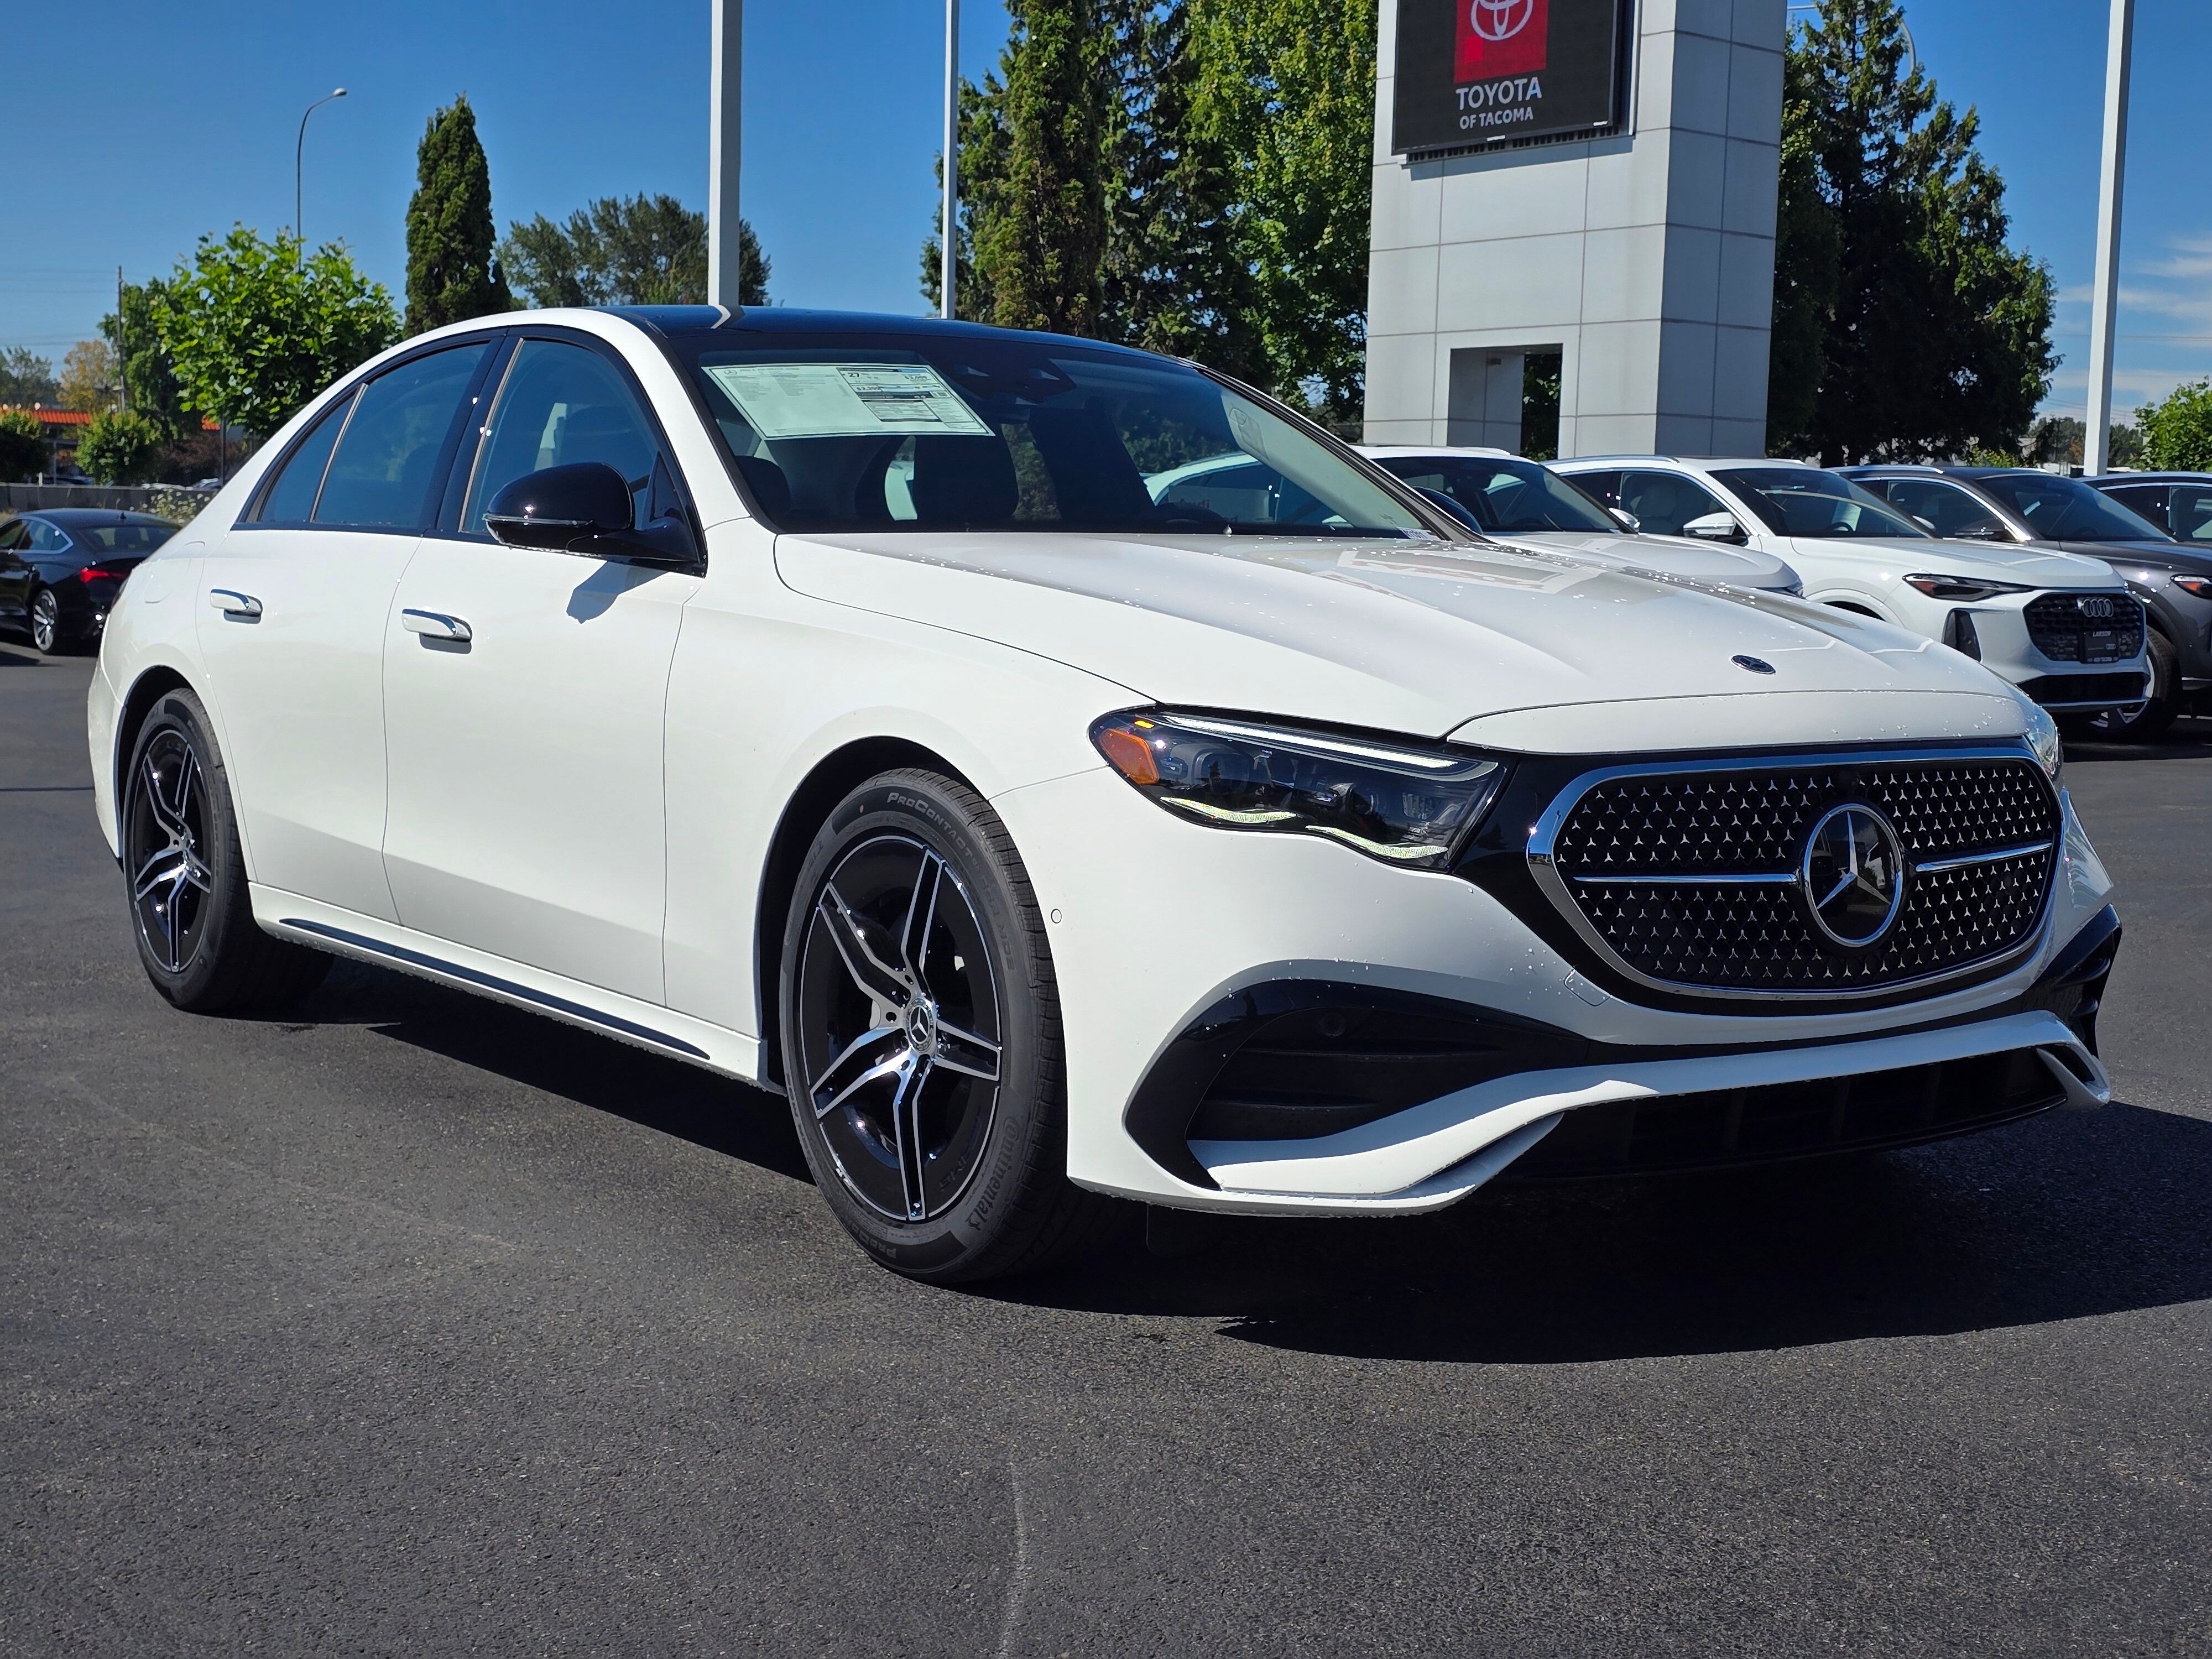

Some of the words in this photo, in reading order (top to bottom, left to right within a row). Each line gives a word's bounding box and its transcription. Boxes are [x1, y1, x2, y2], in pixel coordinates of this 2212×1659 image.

[1455, 77, 1542, 110] TOYOTA
[1460, 114, 1476, 129] OF
[1479, 107, 1533, 127] TACOMA
[971, 1117, 1019, 1224] Continental
